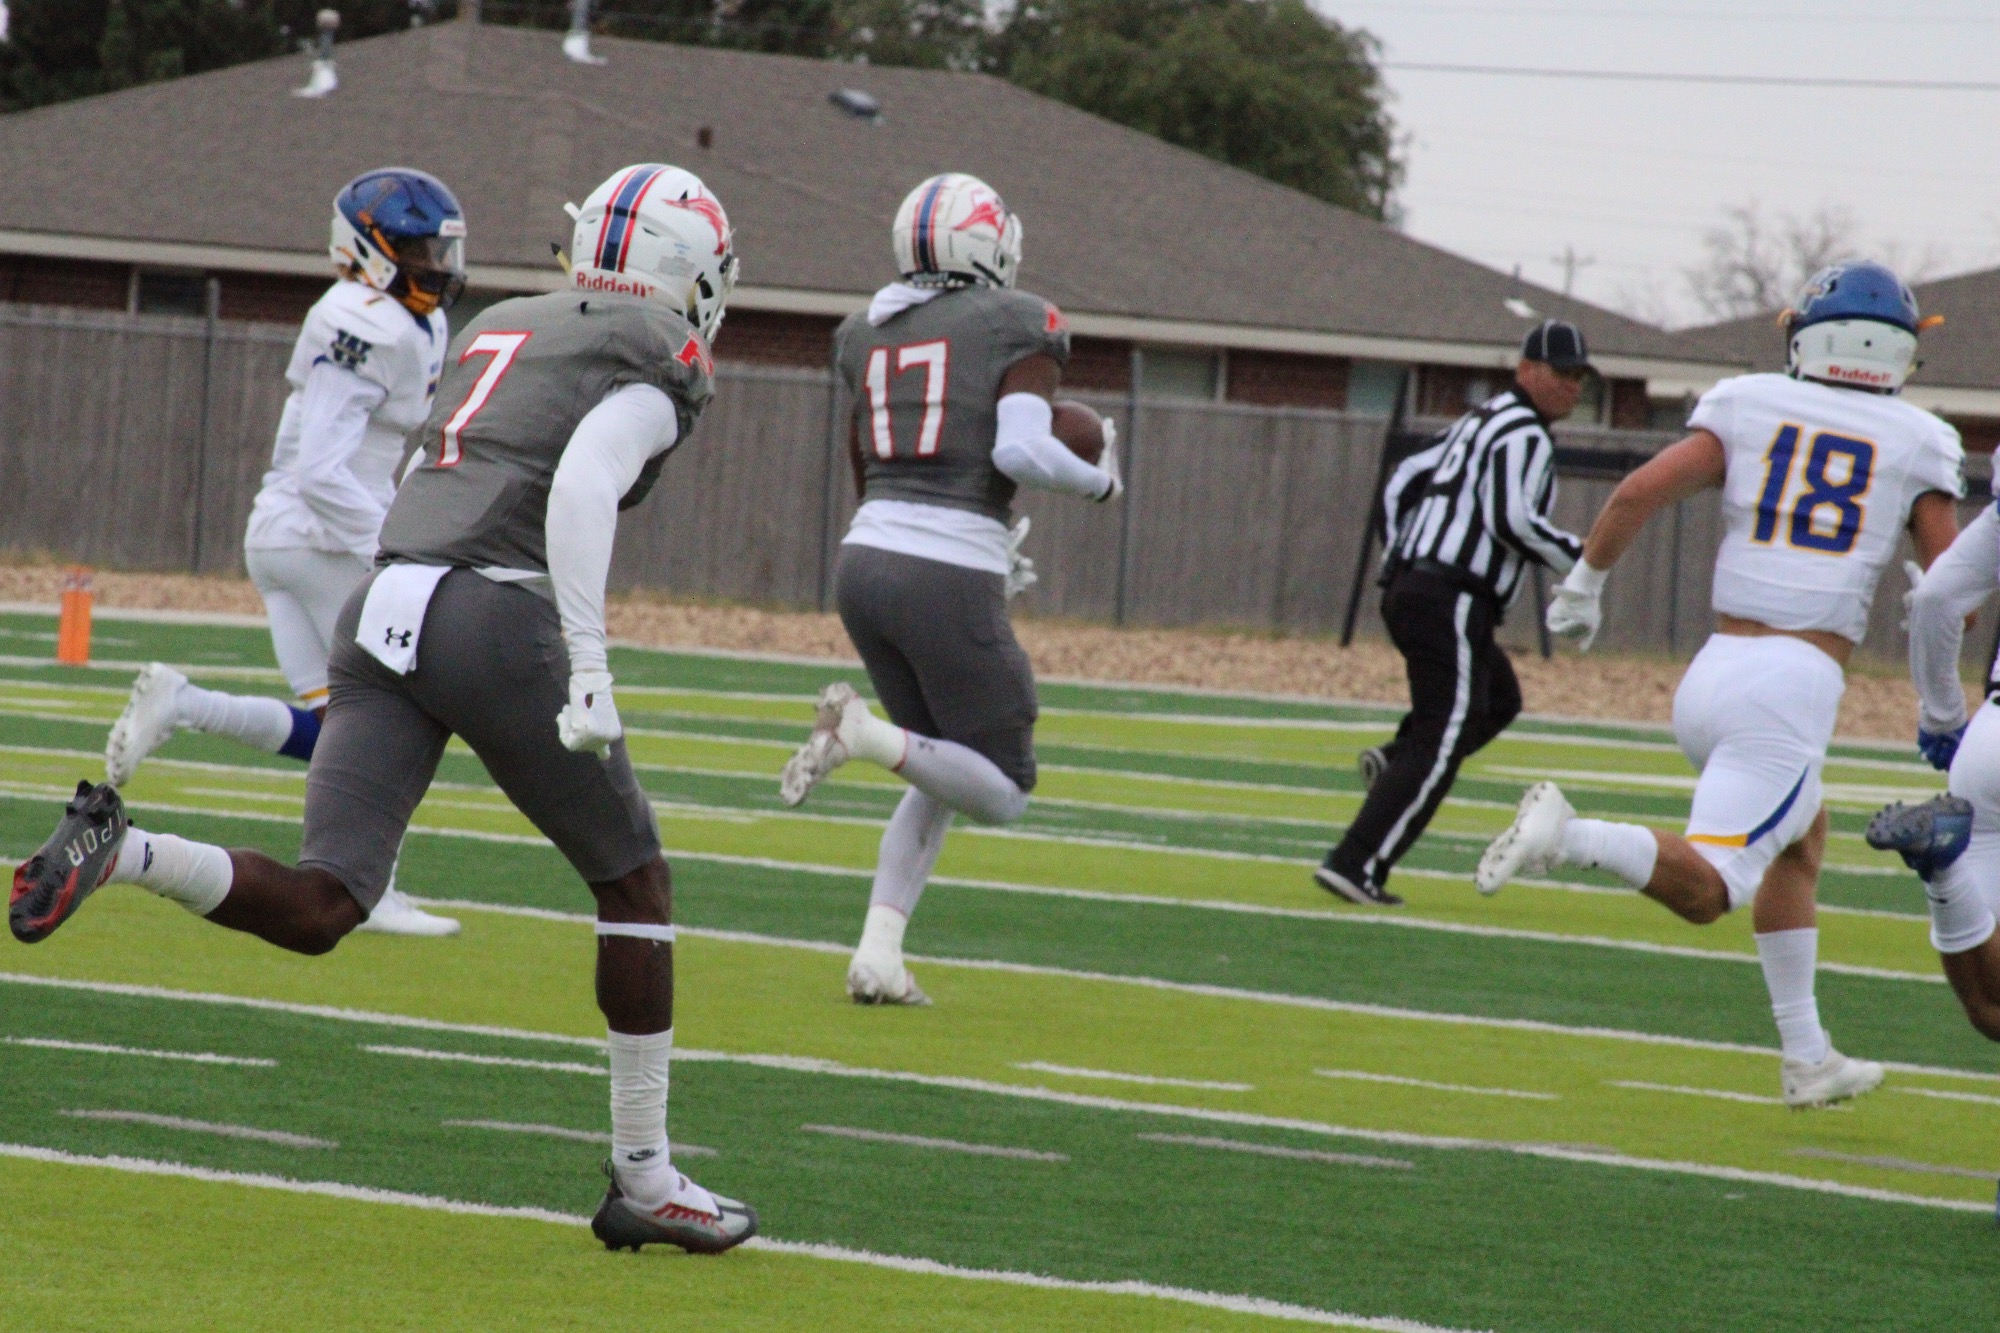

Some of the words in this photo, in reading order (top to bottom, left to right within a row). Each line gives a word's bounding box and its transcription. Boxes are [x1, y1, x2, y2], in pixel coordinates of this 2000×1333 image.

[576, 271, 646, 298] Riddell
[435, 330, 533, 468] 7
[862, 337, 951, 463] 17
[1828, 364, 1892, 382] Riddell
[1748, 420, 1878, 558] 18
